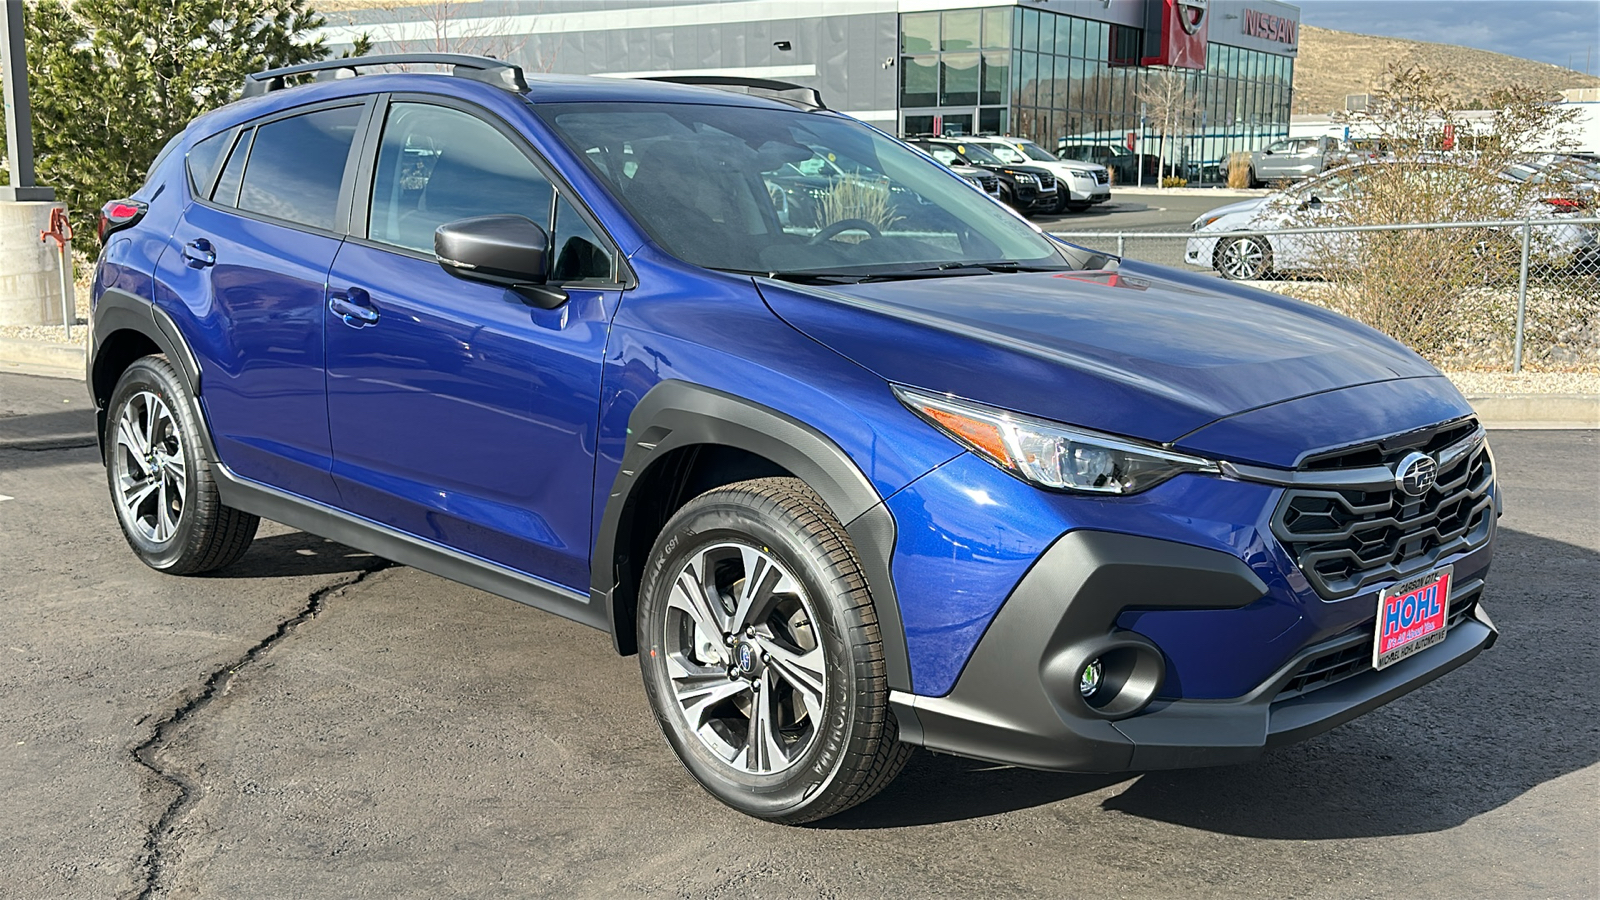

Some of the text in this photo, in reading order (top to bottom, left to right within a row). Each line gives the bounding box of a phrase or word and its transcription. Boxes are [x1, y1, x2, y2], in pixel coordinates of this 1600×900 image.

[1244, 9, 1296, 44] NISSAN
[664, 534, 680, 556] G91
[1400, 572, 1439, 593] CARSON CITY
[1384, 585, 1440, 637] HOHL
[1380, 630, 1445, 665] MICHAEL HOHL AUTOMOTIVE
[1396, 631, 1407, 645] All
[1406, 626, 1424, 640] About
[812, 678, 847, 776] YOKOHAMA
